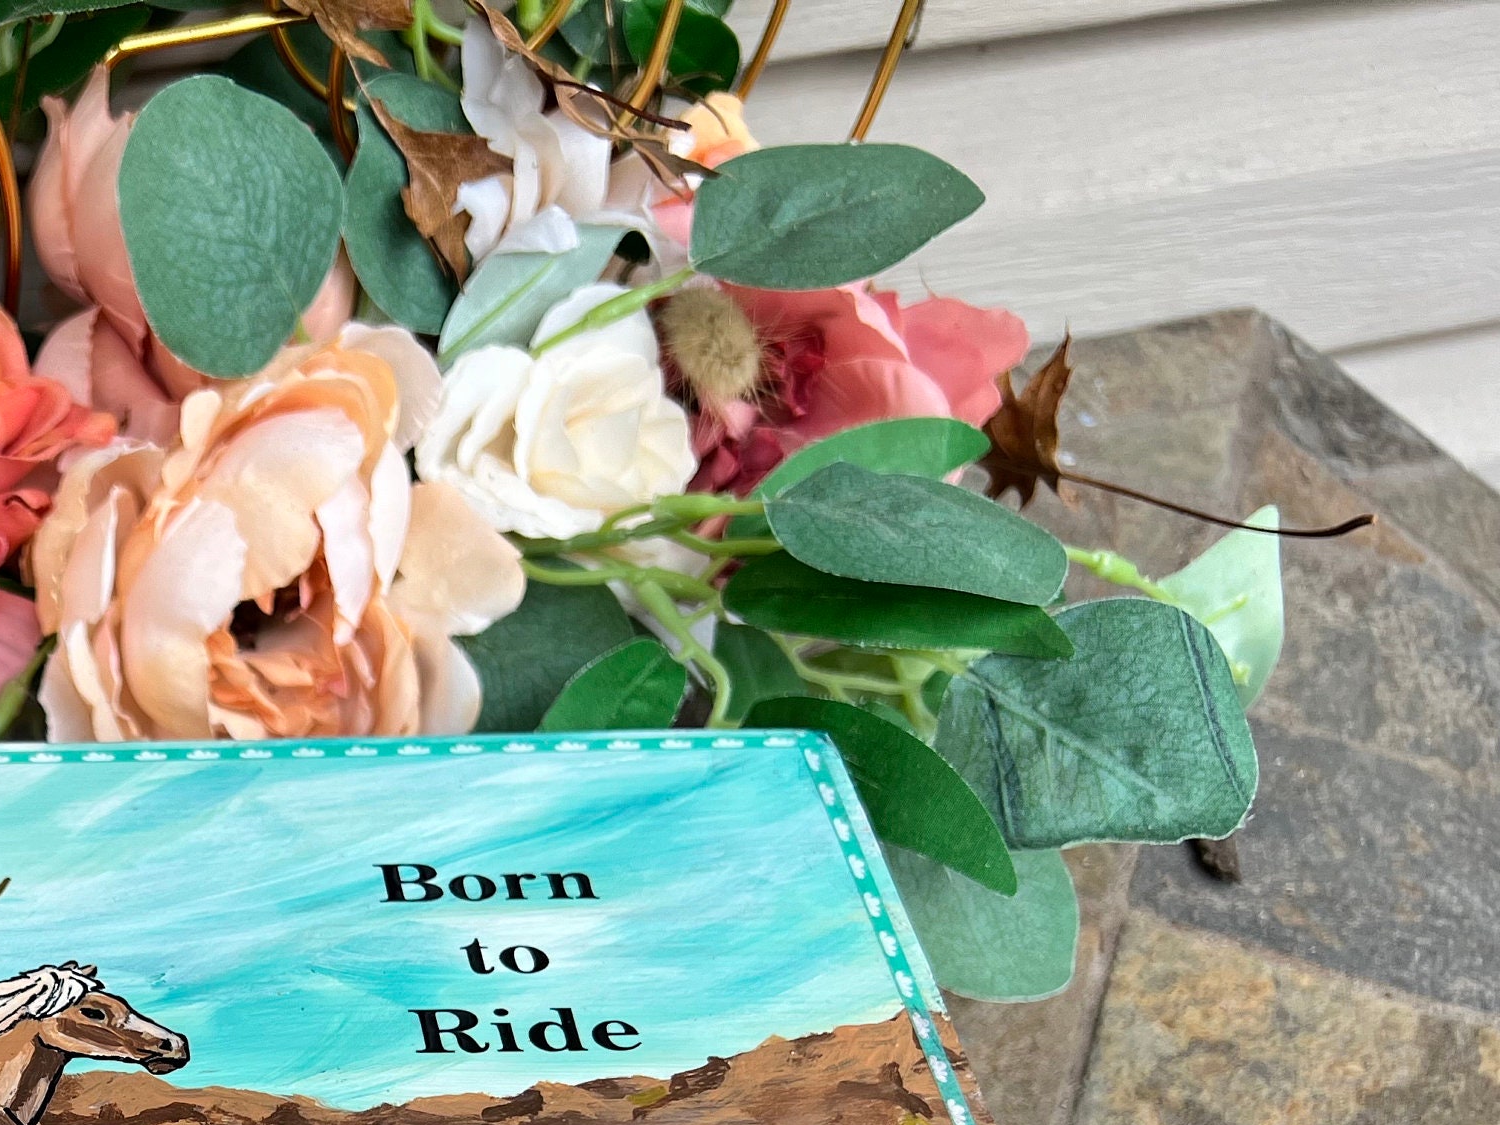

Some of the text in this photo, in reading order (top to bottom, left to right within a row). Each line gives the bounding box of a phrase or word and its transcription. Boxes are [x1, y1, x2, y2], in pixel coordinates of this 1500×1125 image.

[372, 863, 601, 904] Born
[460, 937, 550, 975] to
[408, 1007, 643, 1054] Ride
